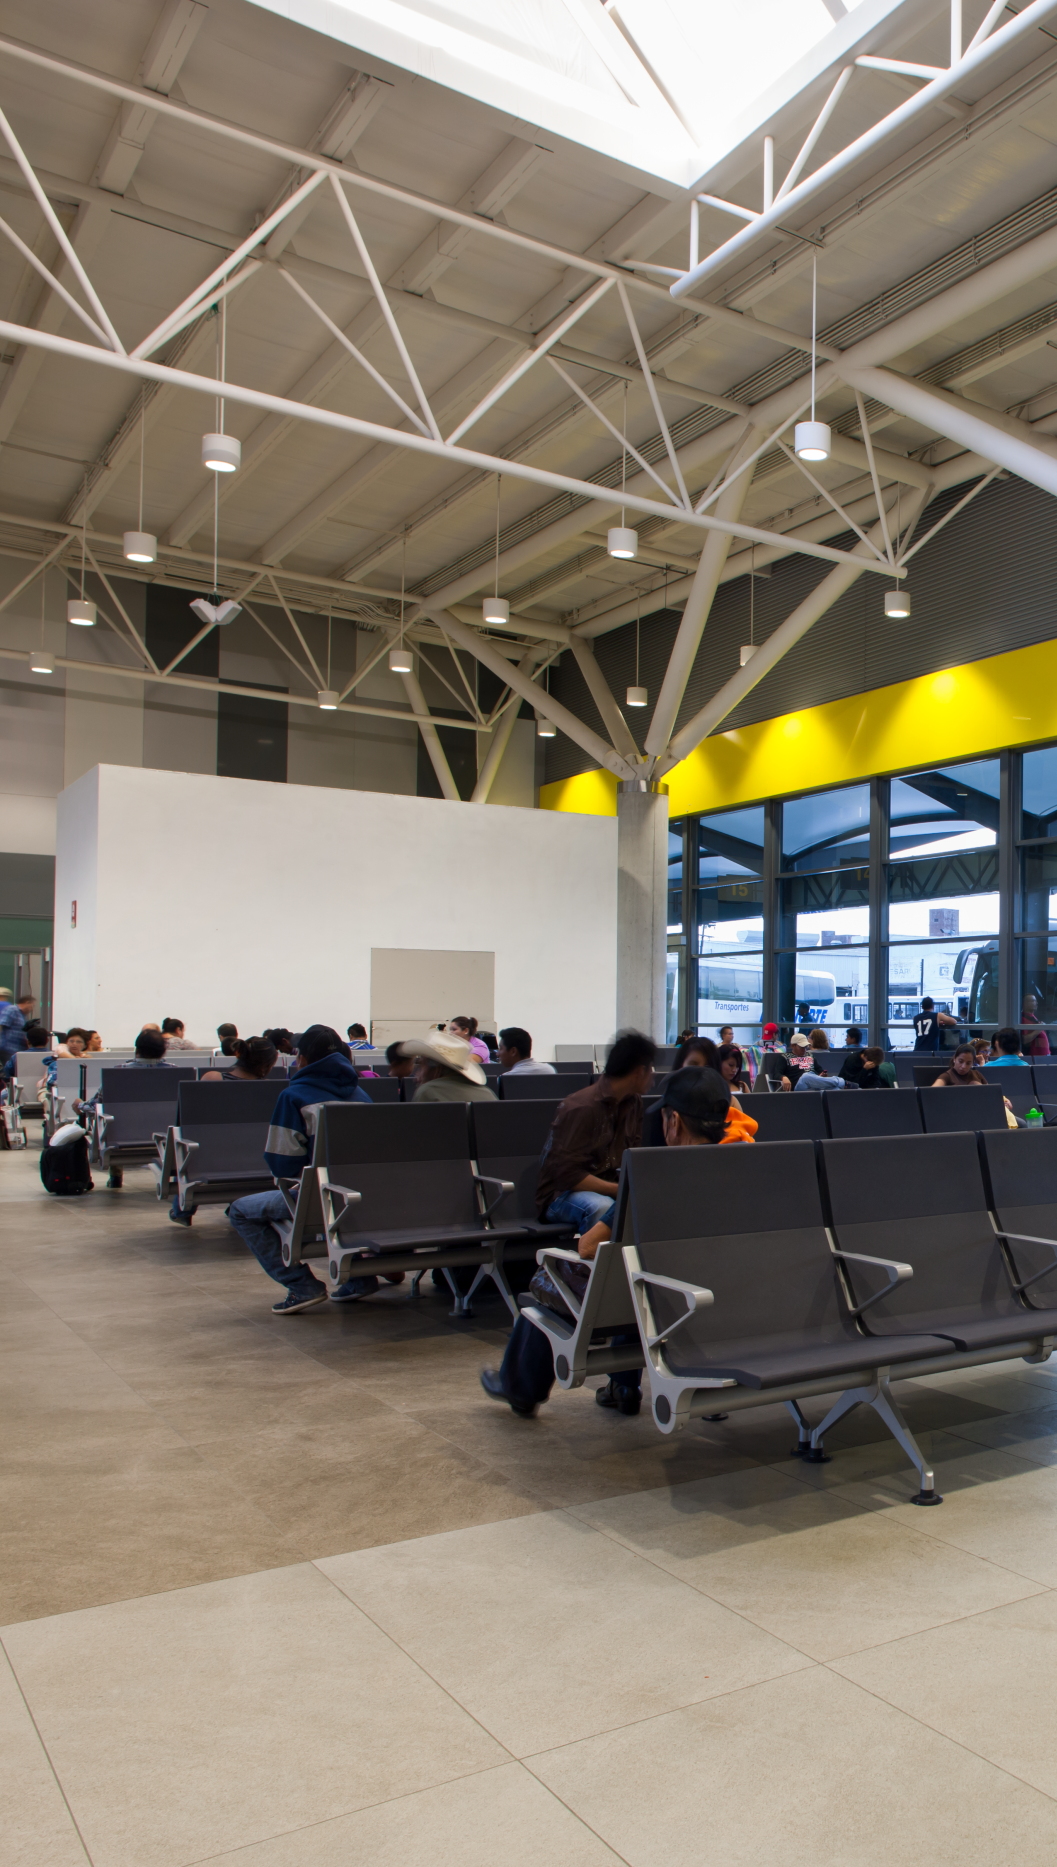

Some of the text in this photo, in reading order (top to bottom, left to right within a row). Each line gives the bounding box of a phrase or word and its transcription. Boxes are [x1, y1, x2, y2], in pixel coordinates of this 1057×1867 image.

[731, 884, 749, 897] 15
[714, 1001, 749, 1013] Transportes
[917, 1019, 932, 1036] 17
